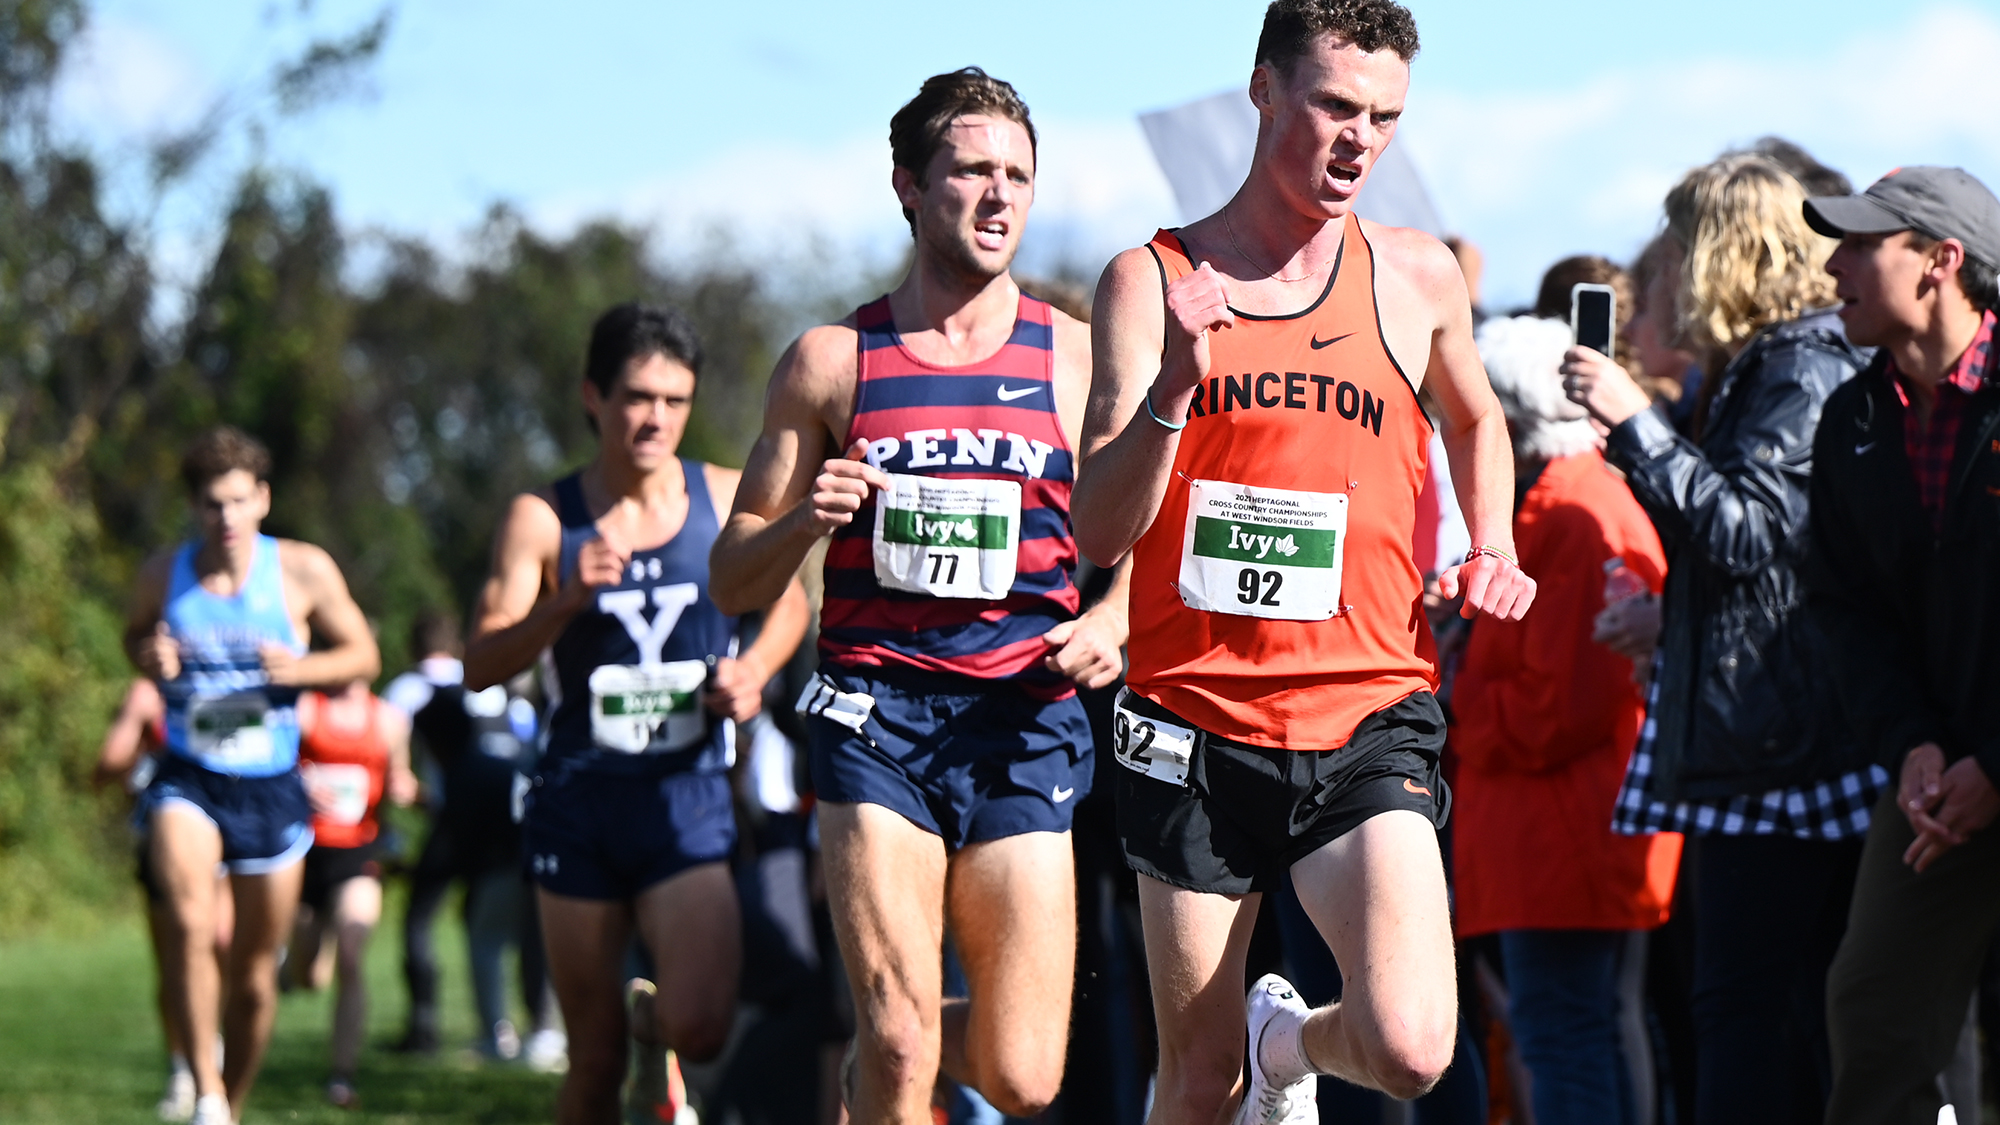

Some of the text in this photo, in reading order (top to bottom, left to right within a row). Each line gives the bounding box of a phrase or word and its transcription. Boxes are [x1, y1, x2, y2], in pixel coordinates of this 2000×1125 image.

[1187, 372, 1384, 437] RINCETON
[867, 428, 1054, 478] PENN
[1209, 499, 1328, 518] CROSS COUNTRY CHAMPIONSHIPS
[1235, 494, 1300, 507] 2021 HEPTAGONAL
[915, 514, 955, 544] Ivy
[1231, 512, 1252, 520] WEST
[1253, 515, 1288, 525] WINDSOR
[1289, 519, 1314, 527] FIELDS
[1228, 525, 1275, 559] Ivy
[928, 554, 959, 584] 77
[1237, 568, 1283, 606] 92
[598, 582, 699, 674] Y
[1115, 711, 1156, 766] 92
